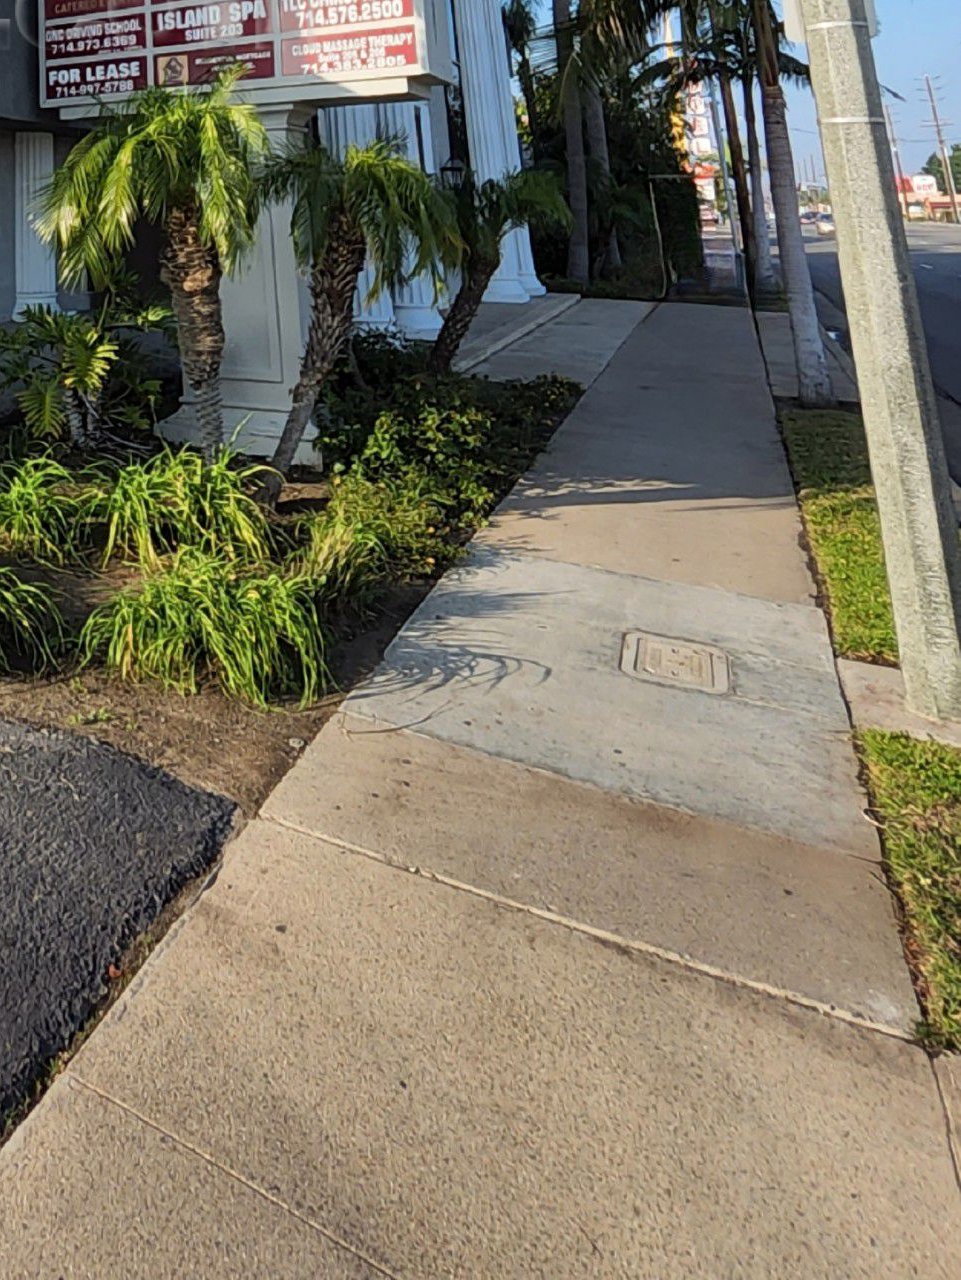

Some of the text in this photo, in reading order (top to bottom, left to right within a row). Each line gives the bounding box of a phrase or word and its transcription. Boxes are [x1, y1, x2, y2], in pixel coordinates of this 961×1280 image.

[104, 19, 142, 35] SCHOOL
[158, 0, 267, 32] ISLAND SPA
[185, 23, 244, 41] SUITE 203
[292, 31, 413, 56] CLOUD MASSAGE THERAPY
[48, 61, 141, 86] FOR LEASE
